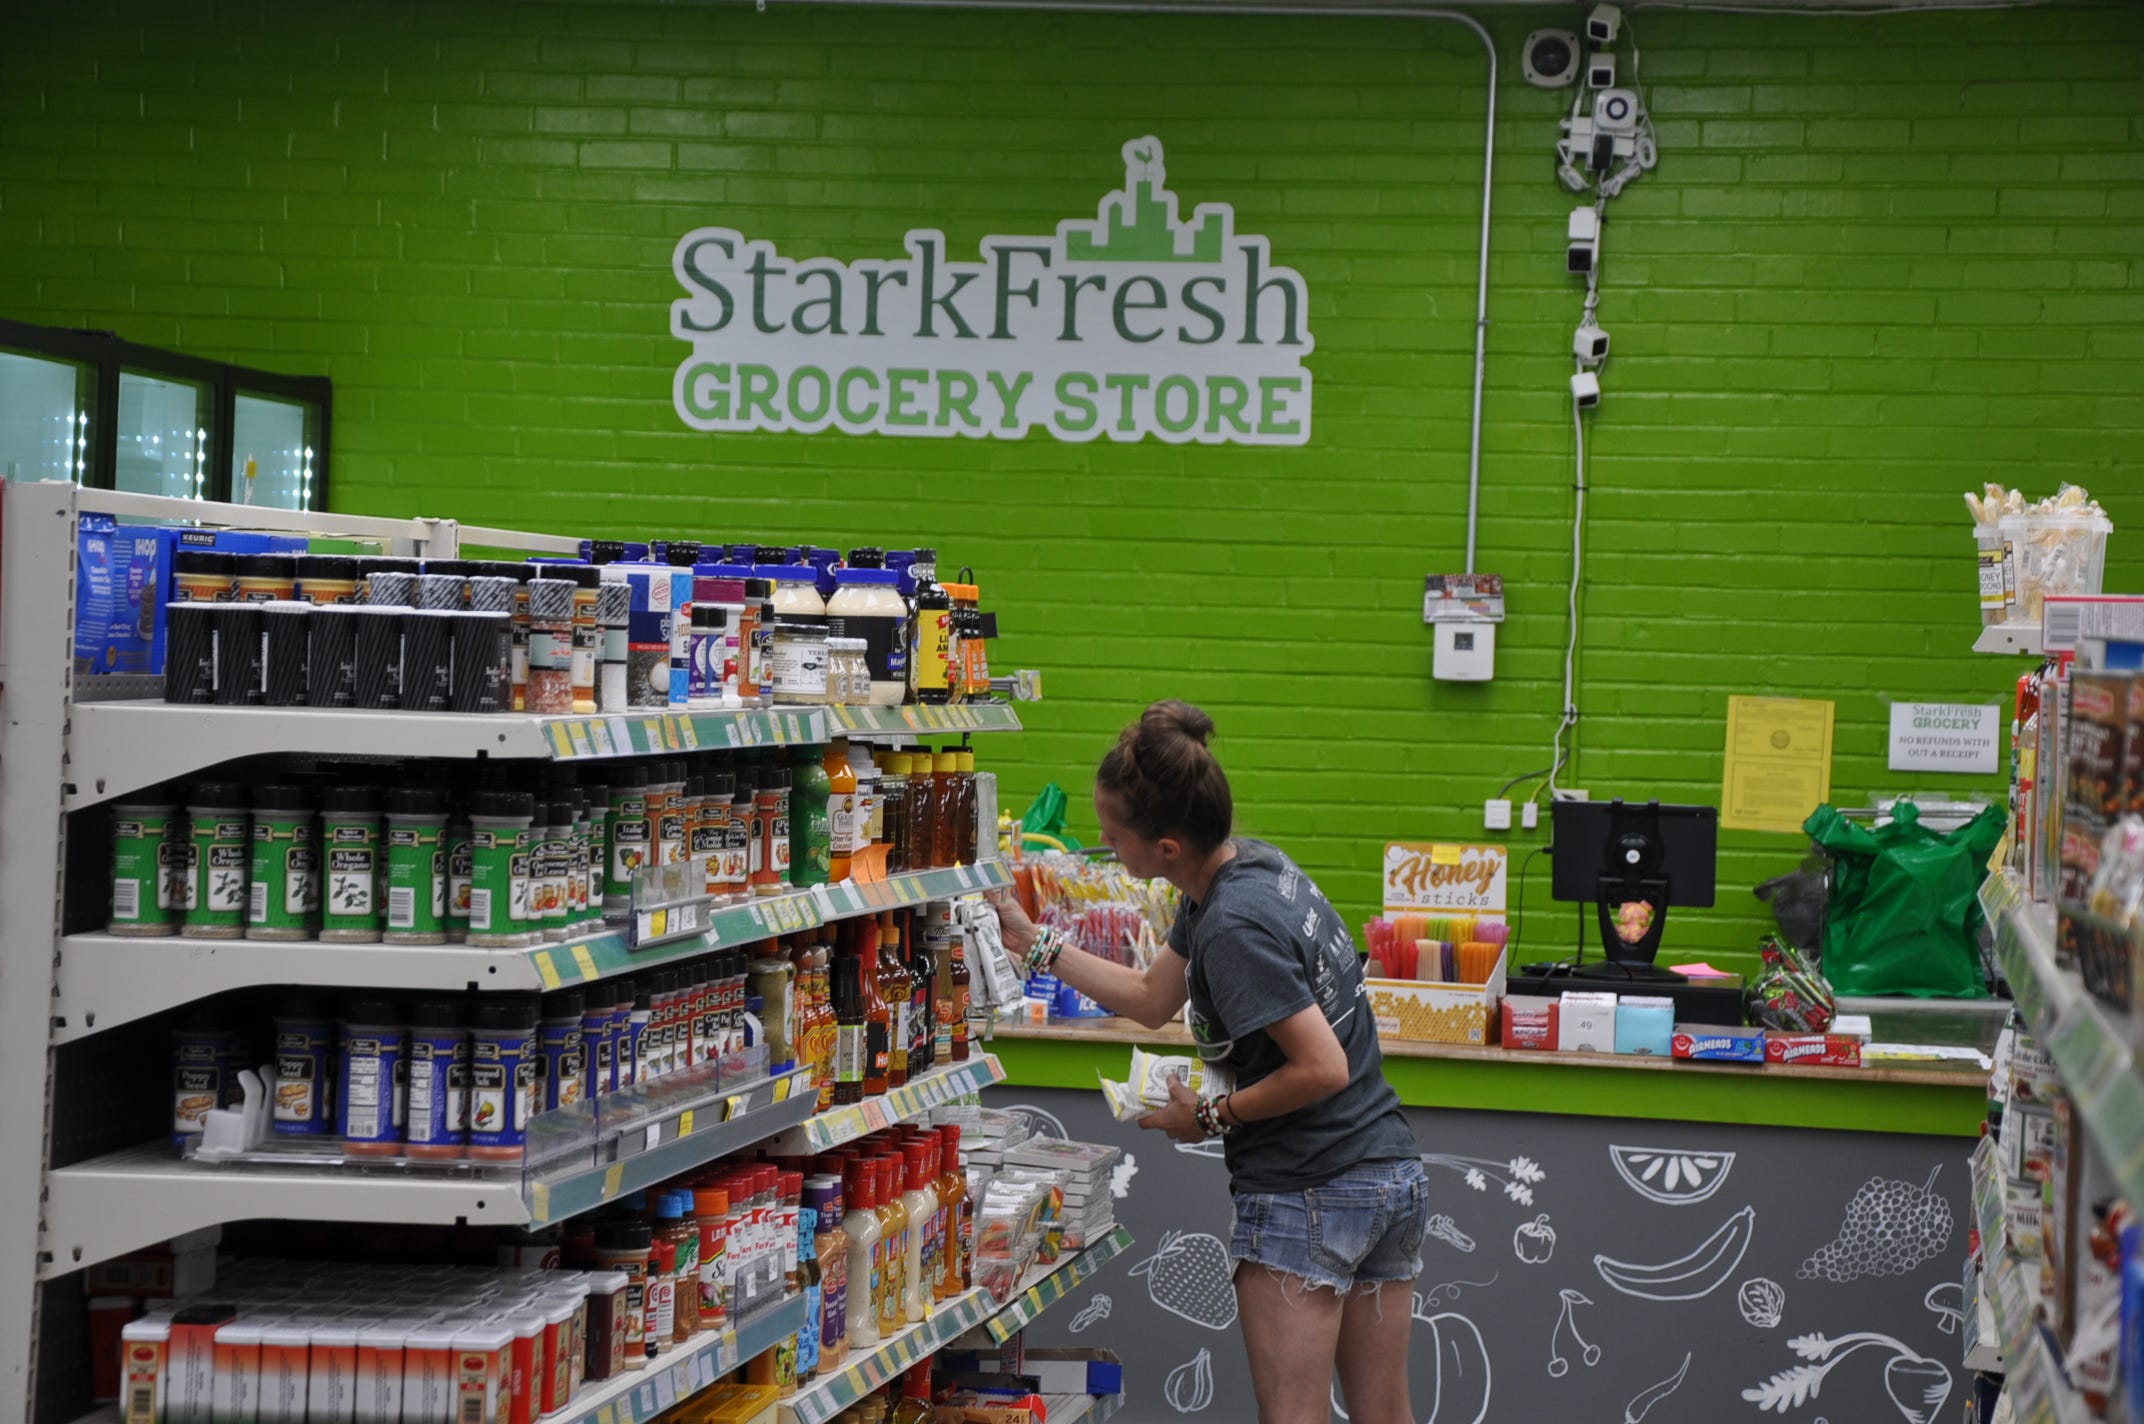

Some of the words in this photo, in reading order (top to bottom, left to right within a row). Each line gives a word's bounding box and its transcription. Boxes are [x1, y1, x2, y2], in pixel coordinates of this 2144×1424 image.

[680, 237, 1304, 346] StarkFresh
[682, 362, 1034, 429] GROCERY
[1053, 371, 1302, 435] STORE
[182, 534, 216, 543] KEURIG
[1912, 717, 1980, 730] GROCERY
[1899, 735, 1914, 745] NO
[1916, 736, 1961, 746] REFUNDS
[1963, 738, 1990, 747] WITH
[1908, 748, 1928, 758] OUT
[1940, 750, 1980, 759] RECEIPT
[336, 851, 366, 862] Whole
[331, 861, 371, 872] Oregano
[1388, 856, 1501, 897] Honey
[1420, 891, 1490, 906] sticks
[1689, 1038, 1732, 1055] AIRHEADS
[1783, 1043, 1826, 1060] AIRHEADS
[2016, 1213, 2040, 1226] Milk
